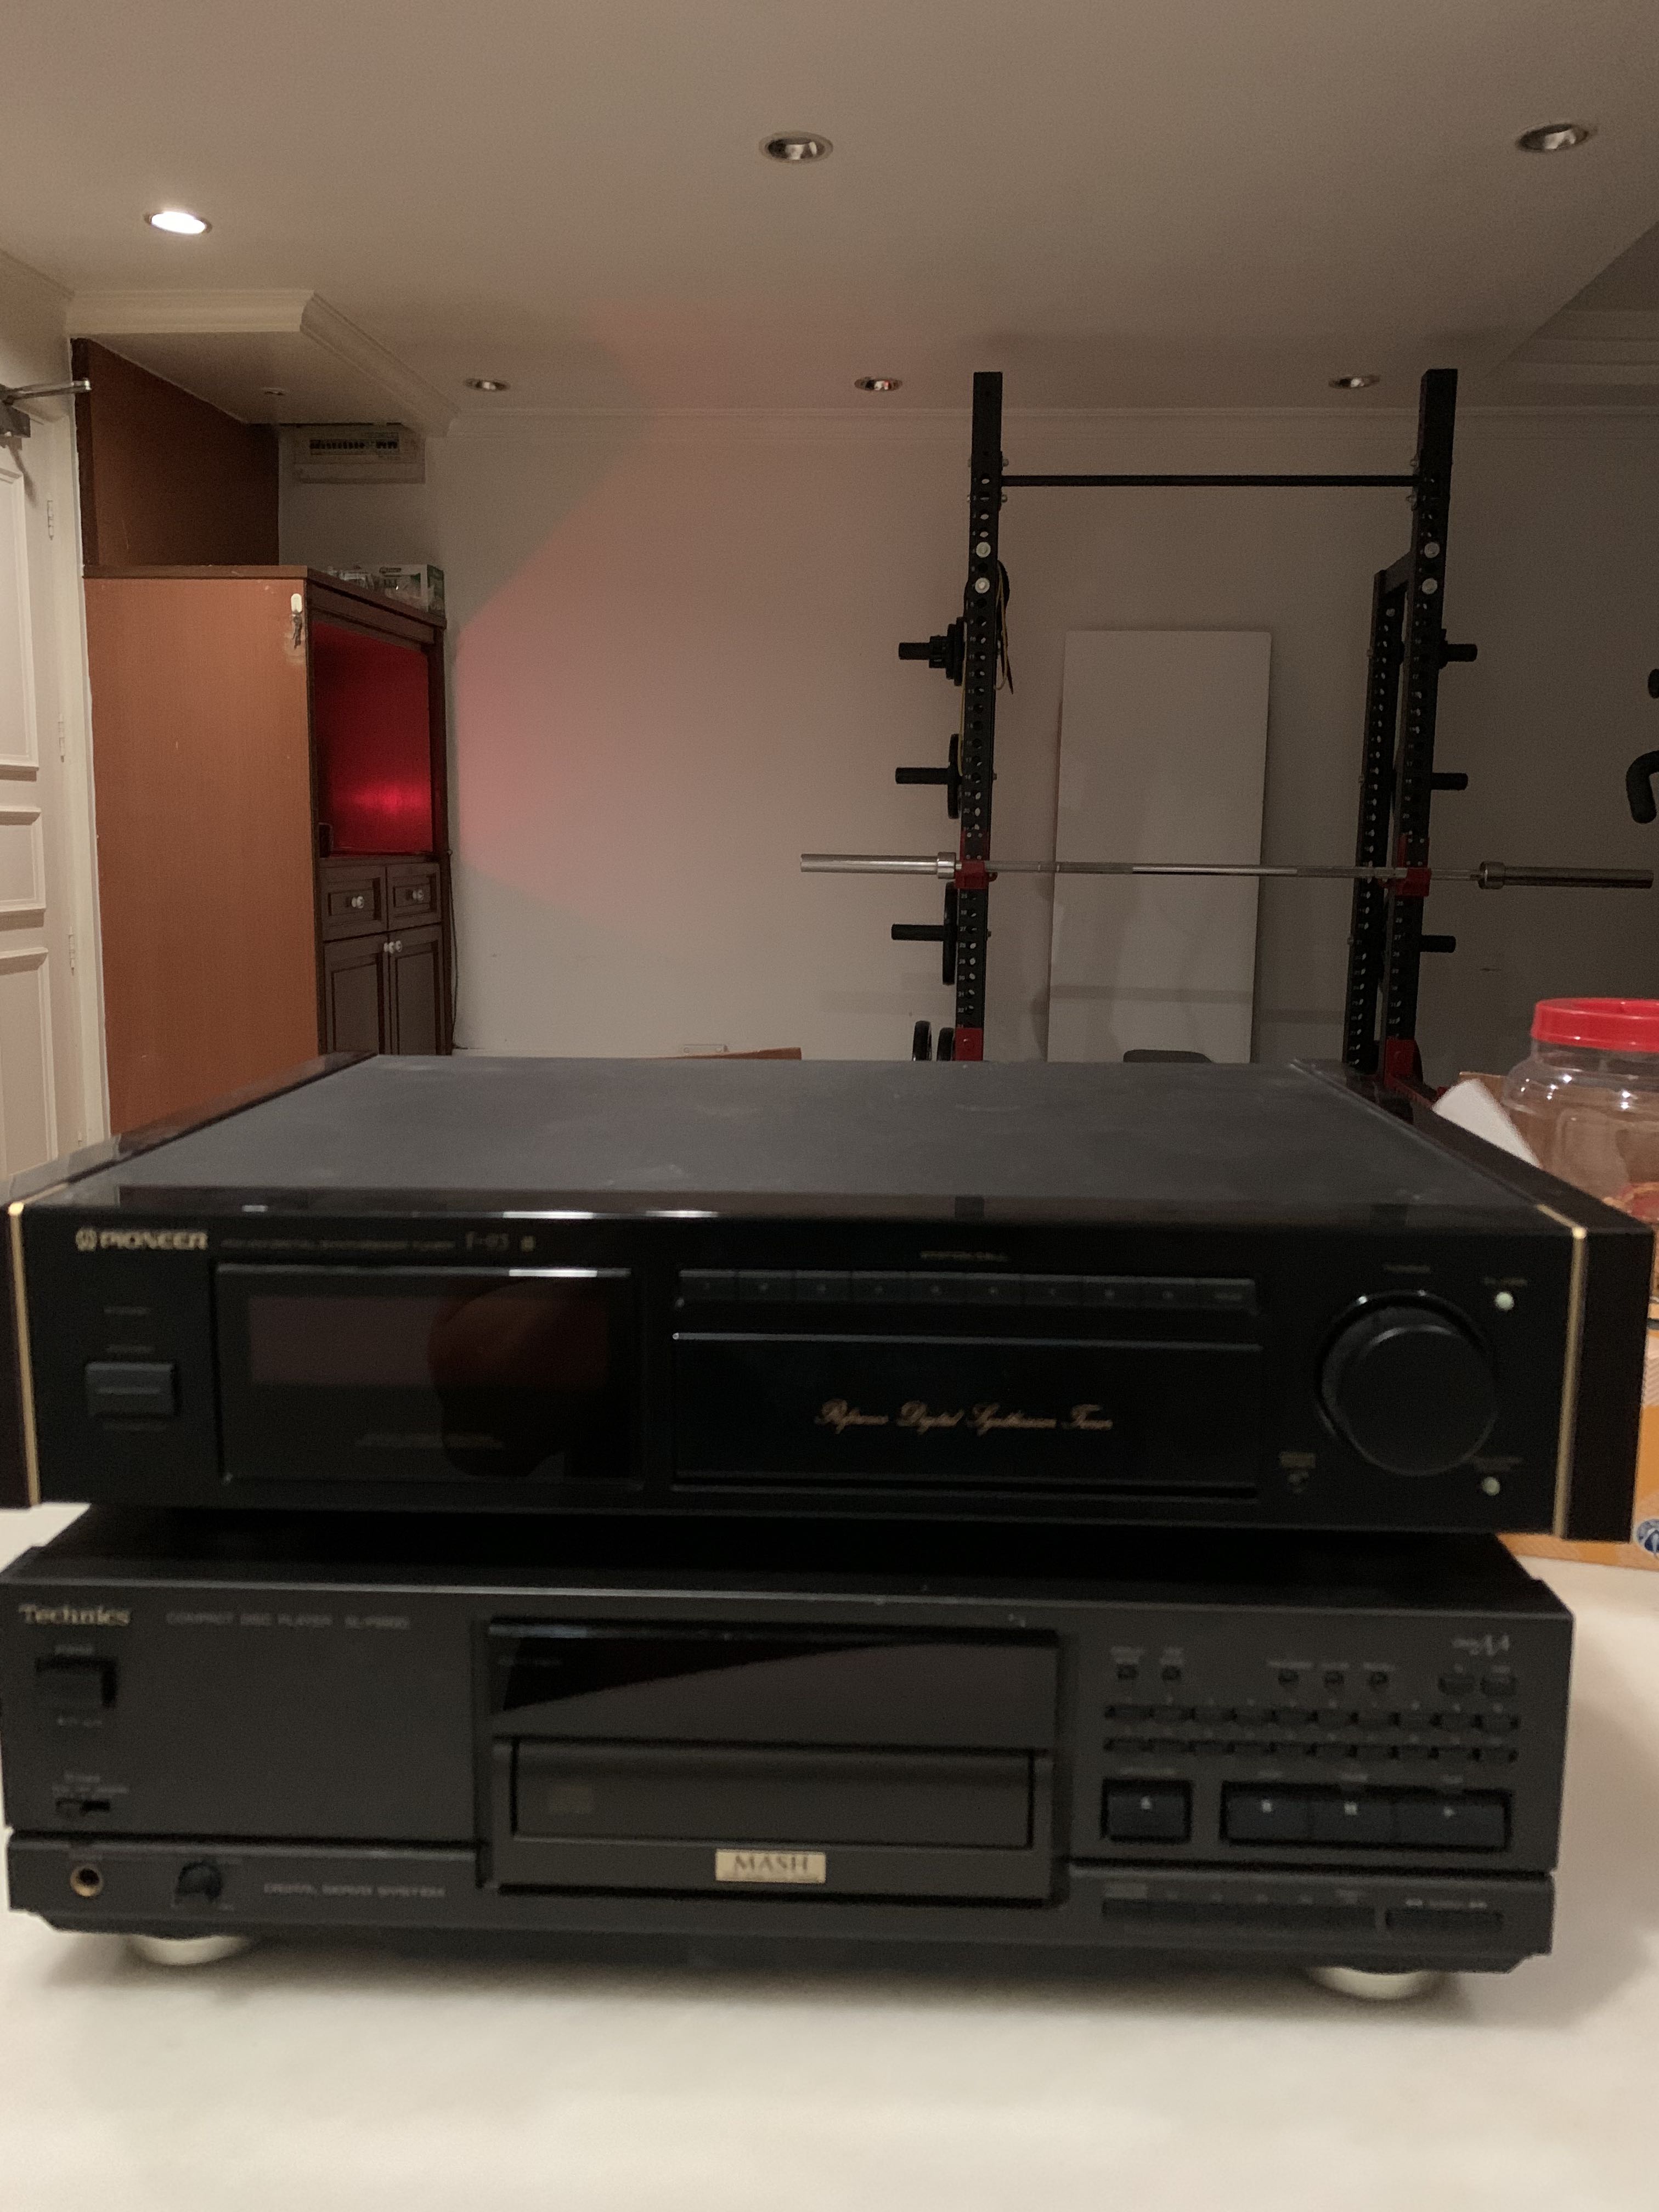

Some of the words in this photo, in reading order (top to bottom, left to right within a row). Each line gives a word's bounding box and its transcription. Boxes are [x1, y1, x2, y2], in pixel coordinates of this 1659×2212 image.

[99, 1231, 208, 1250] PIONEER
[19, 1603, 131, 1626] Technics
[733, 1855, 809, 1871] MASH
